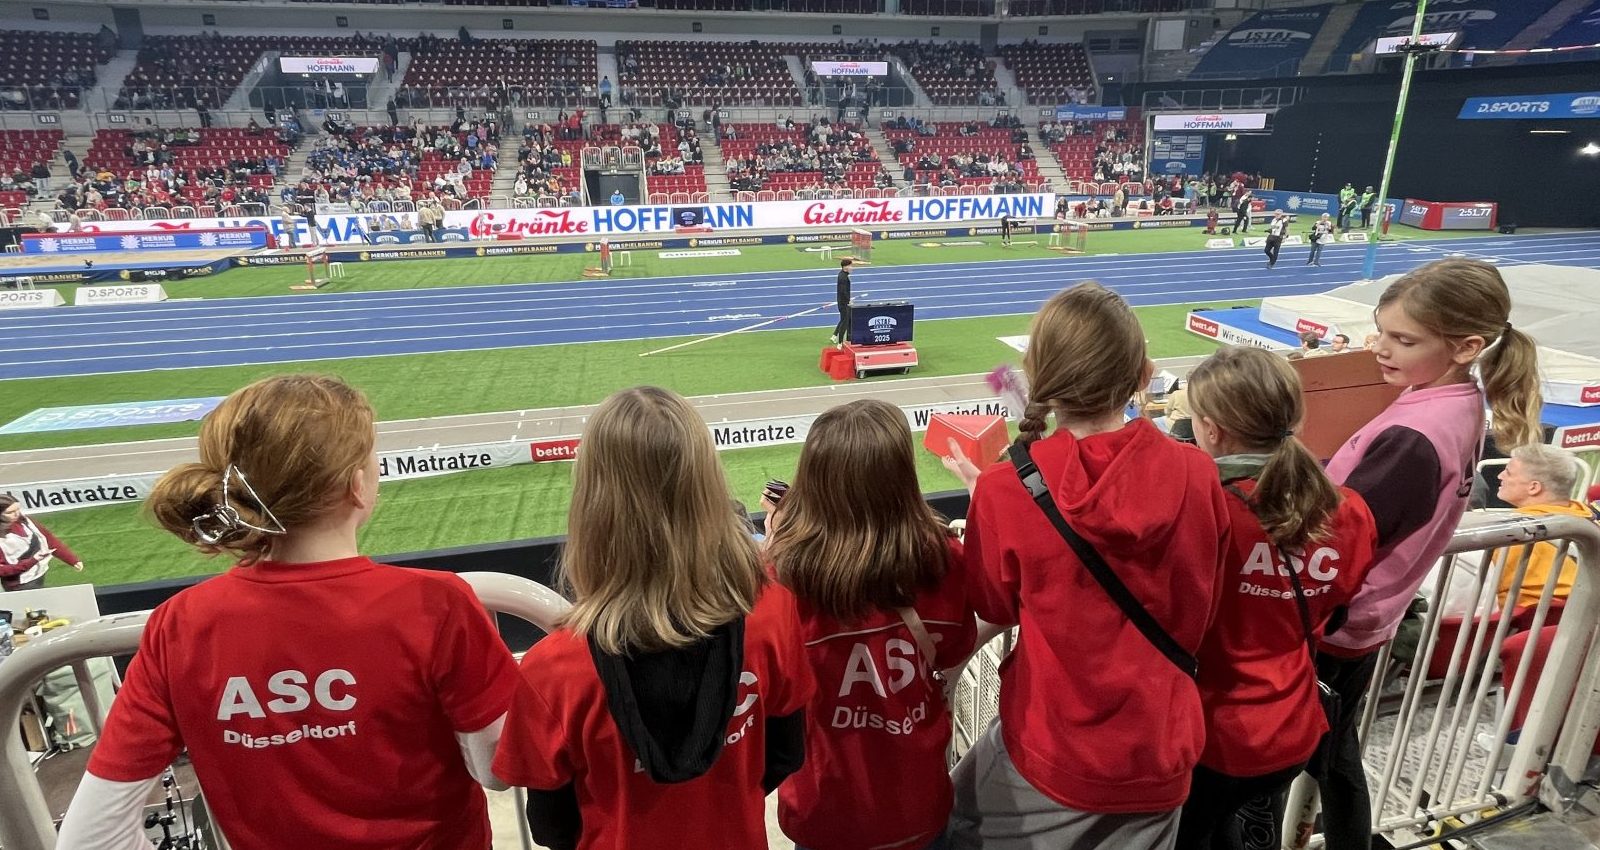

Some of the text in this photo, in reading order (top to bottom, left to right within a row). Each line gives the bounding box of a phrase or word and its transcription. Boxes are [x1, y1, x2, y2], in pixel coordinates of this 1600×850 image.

[307, 65, 355, 73] HOFFMANN
[831, 67, 869, 75] HOFFMANN
[1477, 101, 1550, 113] D.SPORTS
[1184, 121, 1233, 129] HOFFMANN
[803, 196, 1044, 225] Getränke HOFFMANN
[1457, 207, 1492, 217] 2:51.77
[469, 210, 588, 238] Gtränke
[592, 205, 754, 234] HOFFANN
[61, 237, 96, 245] MERKUR
[621, 241, 663, 249] SPIELBANKEN
[400, 250, 446, 258] SPIELBANKEN
[513, 245, 557, 253] SPIELBANKEN
[88, 286, 149, 298] D.SPORTS
[1191, 319, 1217, 335] bett1.de
[1222, 329, 1235, 342] Wir
[874, 334, 891, 343] 2025
[713, 424, 796, 447] Matratze
[397, 453, 492, 476] Matratze
[22, 482, 139, 510] Matratze
[838, 638, 916, 699] AS
[217, 668, 358, 721] ASC
[223, 720, 357, 748] Düsseldorf
